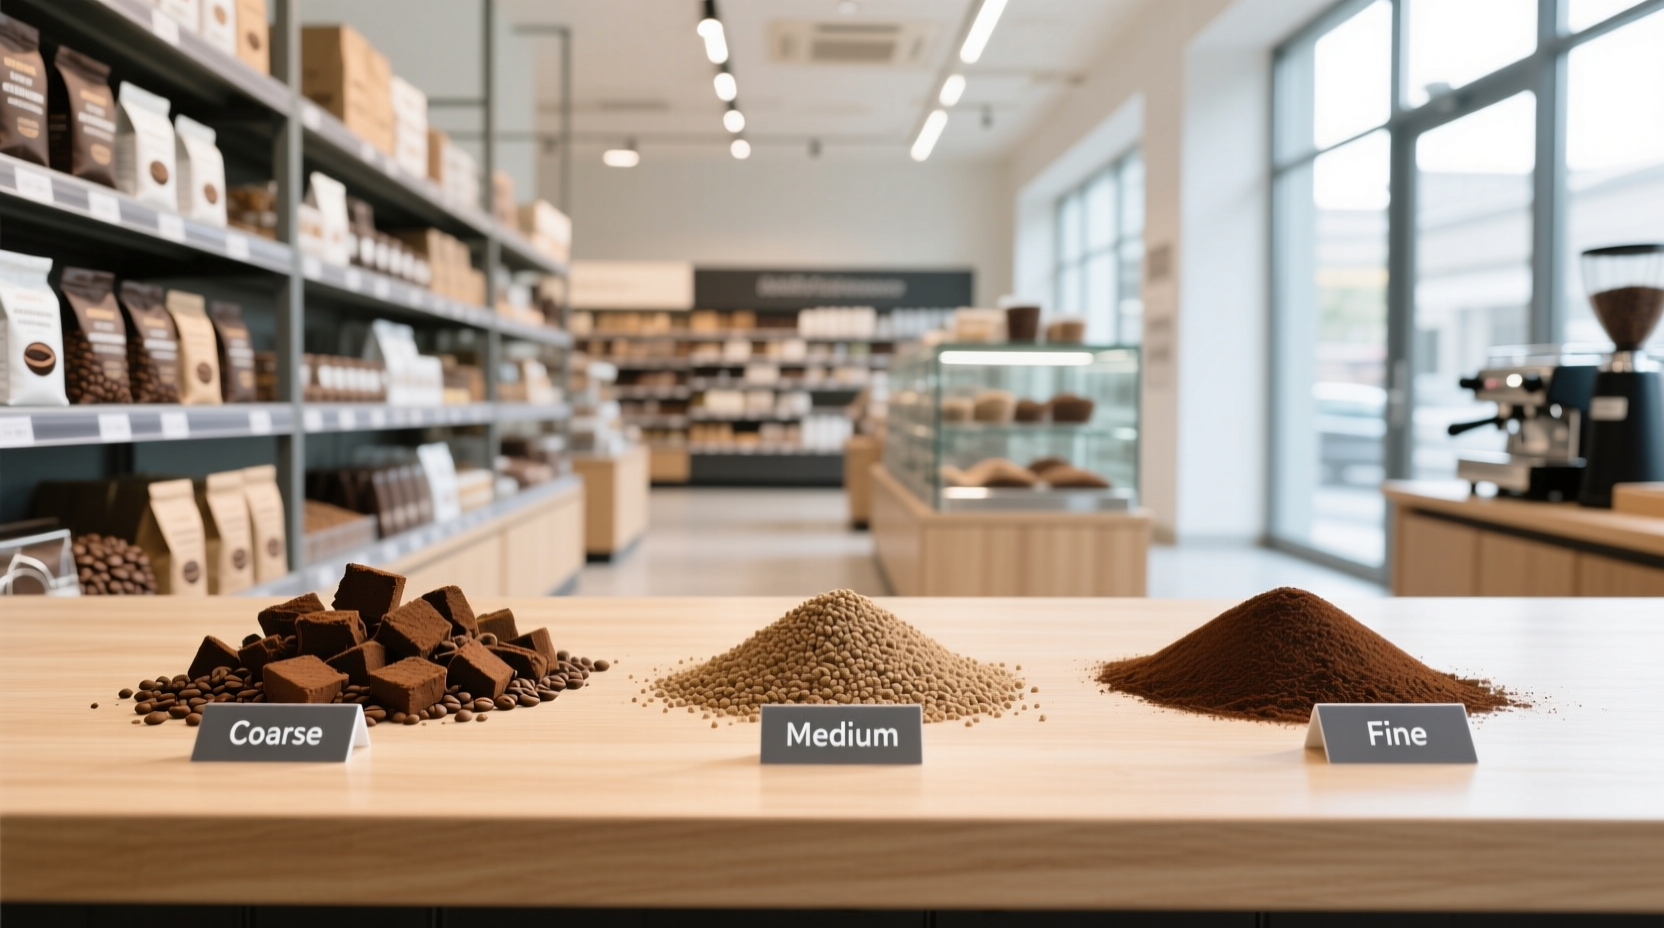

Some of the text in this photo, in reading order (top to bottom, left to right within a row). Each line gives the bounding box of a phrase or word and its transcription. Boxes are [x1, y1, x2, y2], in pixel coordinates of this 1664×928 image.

[230, 720, 322, 746] Coarse
[787, 721, 898, 748] Medium
[1367, 721, 1428, 747] Fine
